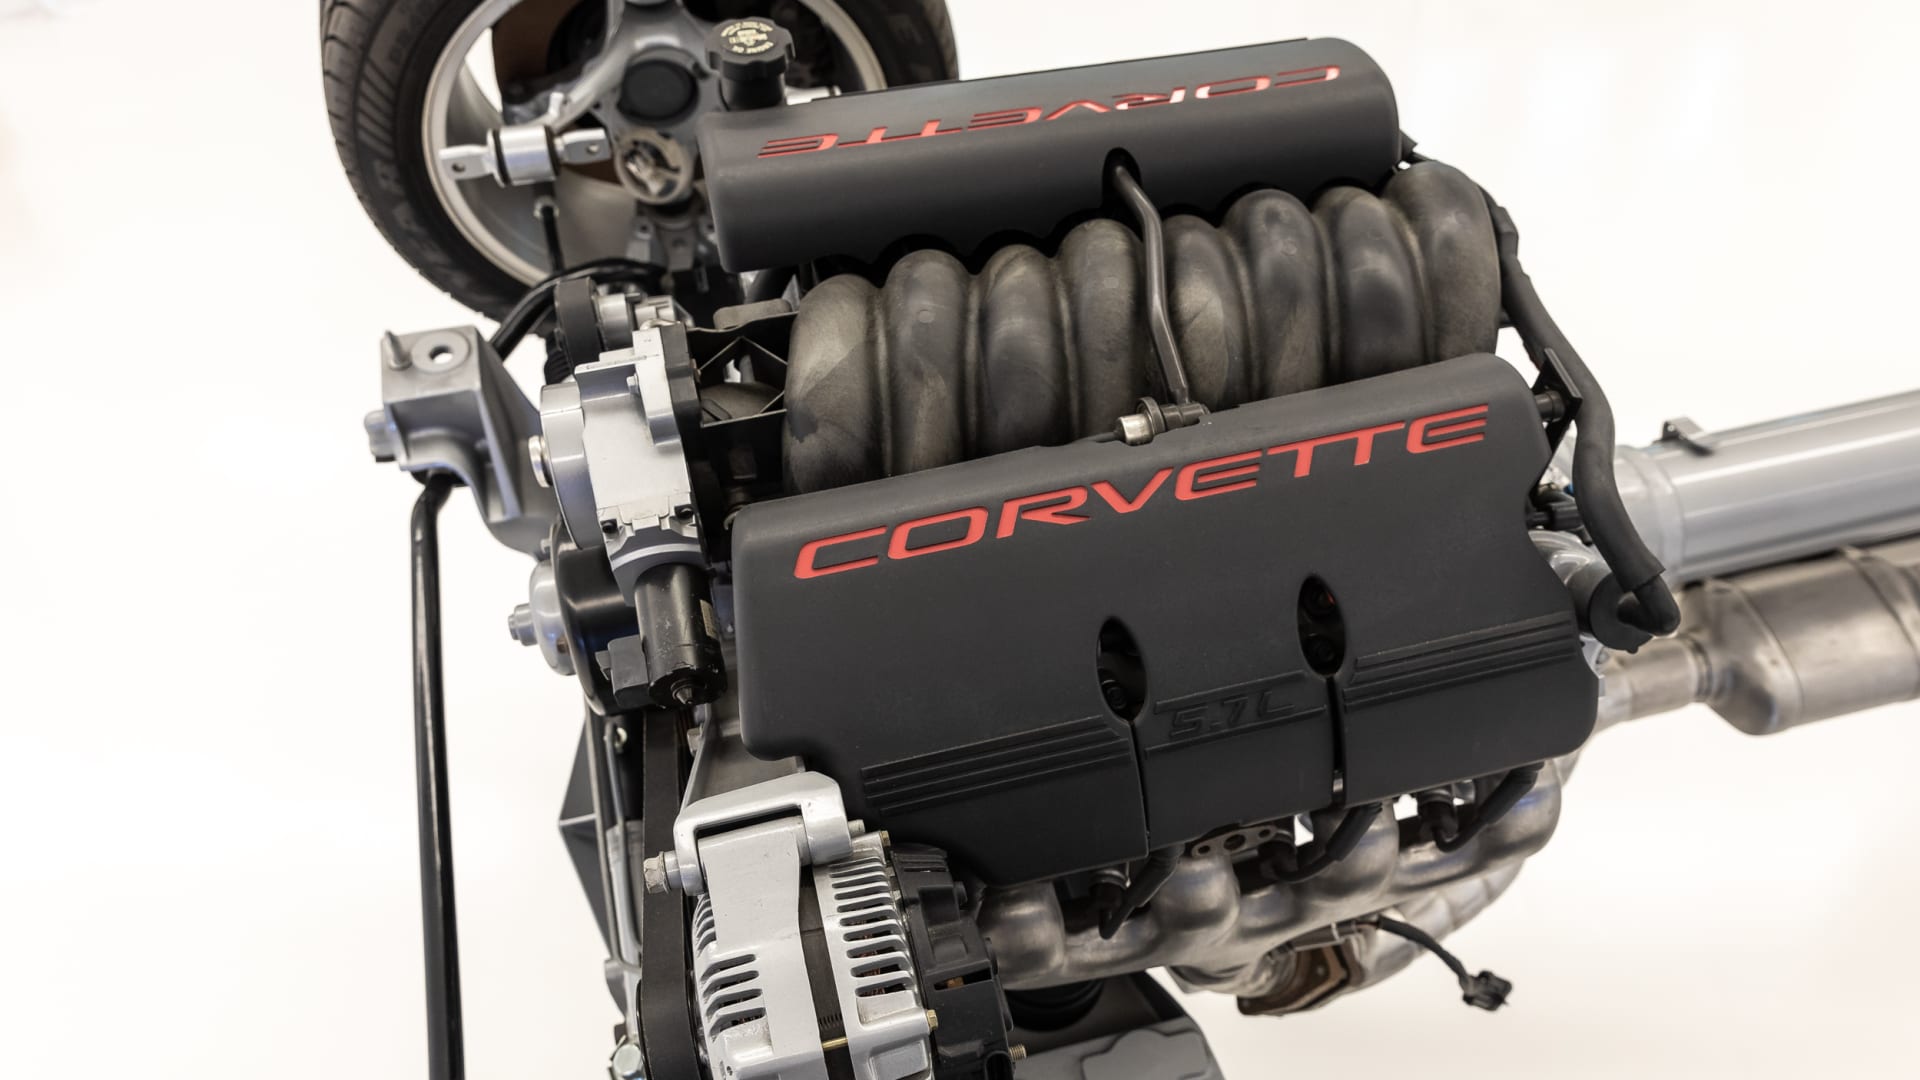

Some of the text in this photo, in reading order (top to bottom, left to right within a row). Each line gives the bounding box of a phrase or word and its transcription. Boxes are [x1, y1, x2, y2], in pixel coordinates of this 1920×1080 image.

[757, 65, 1340, 159] CORVETTE
[793, 404, 1489, 580] CORVETTE
[1170, 689, 1296, 738] 5.7L
